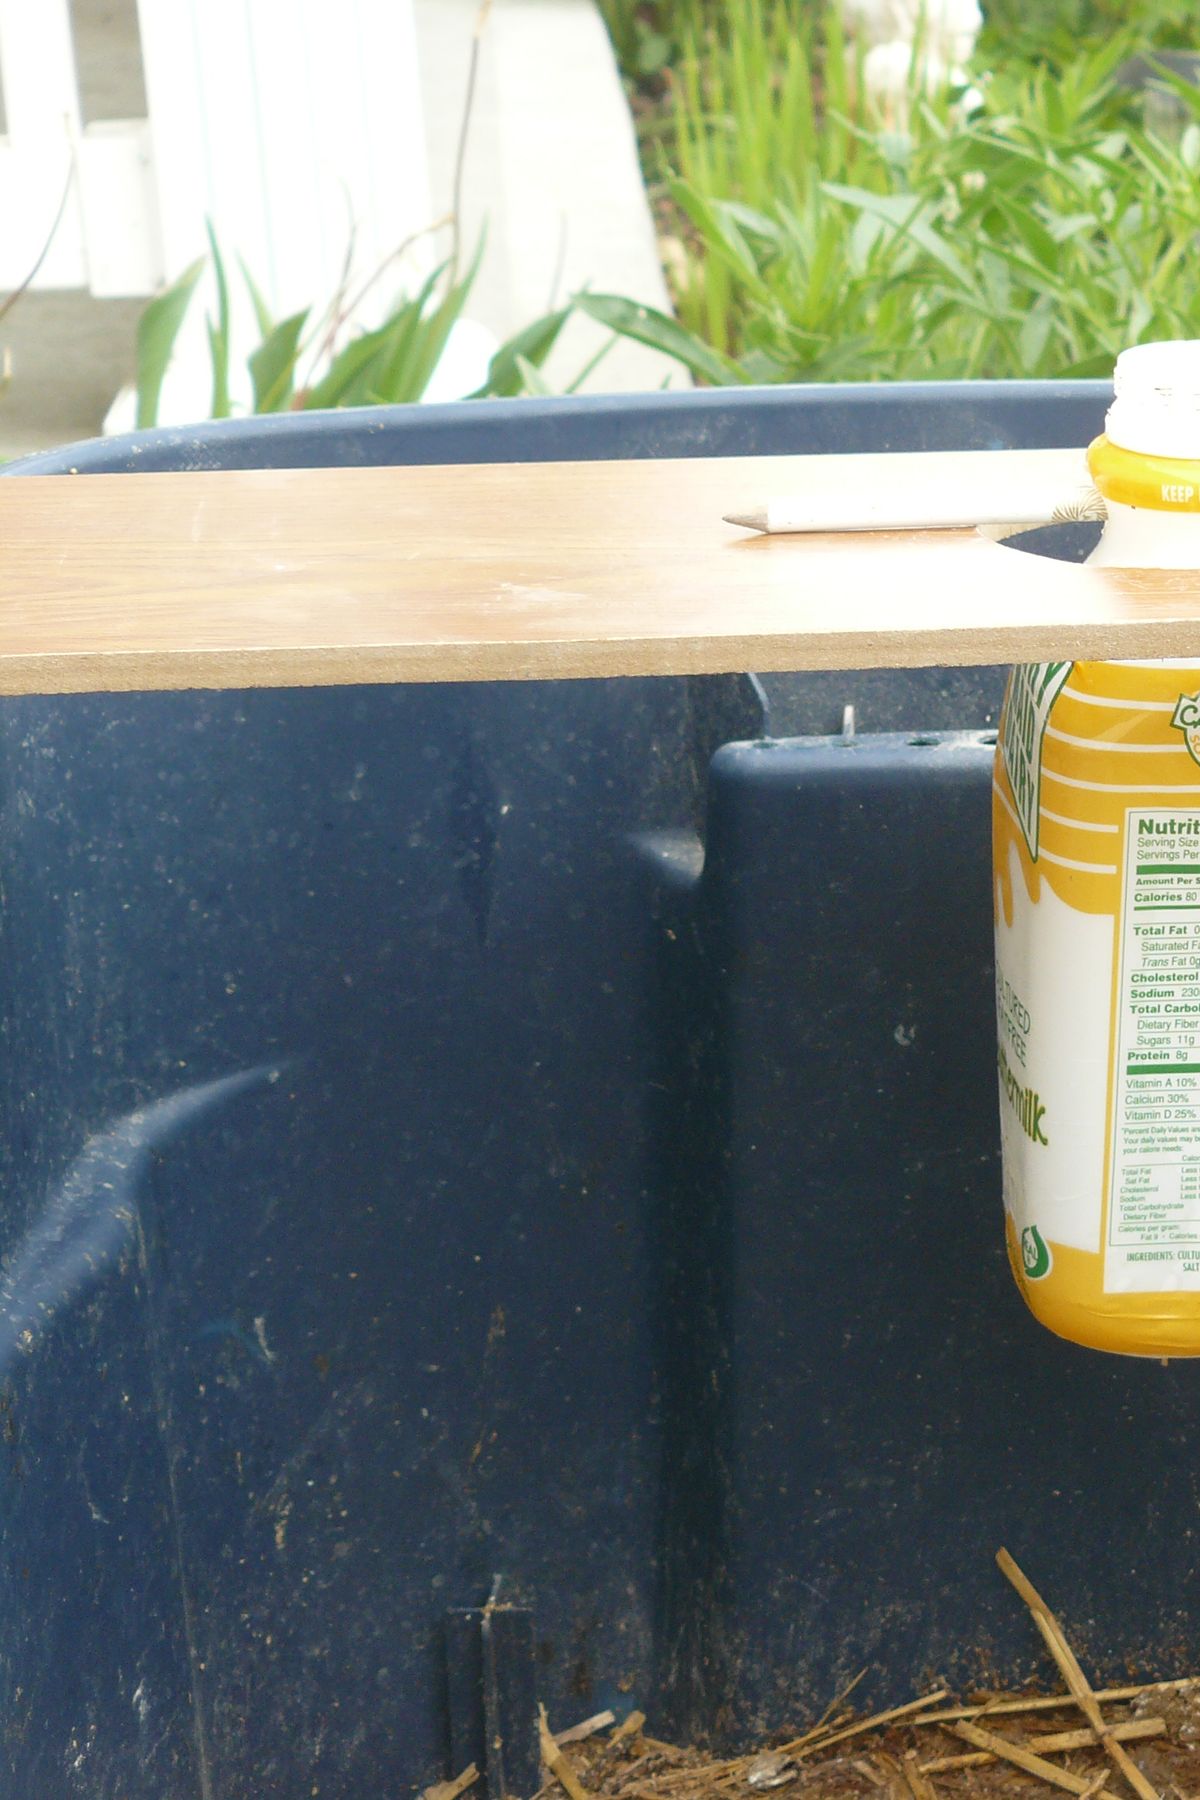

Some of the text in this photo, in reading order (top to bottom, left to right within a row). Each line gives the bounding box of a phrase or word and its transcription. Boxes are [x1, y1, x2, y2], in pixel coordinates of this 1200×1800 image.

[1162, 485, 1193, 502] KEEP
[1138, 838, 1175, 848] Serving
[1179, 837, 1198, 847] Size
[1137, 850, 1180, 861] Servings
[1183, 850, 1199, 859] Per
[1134, 892, 1182, 902] Calories
[1186, 892, 1197, 901] 80
[1133, 926, 1165, 935] Total
[1169, 926, 1187, 935] Fat
[1141, 941, 1189, 951] Saturated
[1142, 957, 1200, 968] Trans Fat 0g
[1131, 972, 1198, 983] Cholesterol
[1131, 989, 1174, 999] Sodium
[1130, 1005, 1160, 1014] Total
[1138, 1020, 1171, 1030] Dietary
[1175, 1019, 1198, 1028] Fiber
[1137, 1035, 1195, 1046] Sugars 11g
[1128, 1051, 1170, 1061] Protein
[1176, 1051, 1188, 1062] 8g
[1126, 1079, 1162, 1088] Vitamin
[1165, 1078, 1172, 1087] A
[1176, 1078, 1197, 1087] 10%
[998, 1045, 1049, 1146] ermilk
[1125, 1095, 1164, 1105] Calcium
[1168, 1094, 1189, 1103] 30%
[1124, 1109, 1196, 1120] Vitamin D 25%
[1151, 1126, 1166, 1135] Daily
[1168, 1126, 1188, 1134] Values
[1141, 1135, 1155, 1144] daily
[1180, 1136, 1192, 1144] may
[1123, 1147, 1138, 1155] your
[1127, 1252, 1174, 1262] INGREDIENTS:
[1183, 1263, 1199, 1271] SALT
